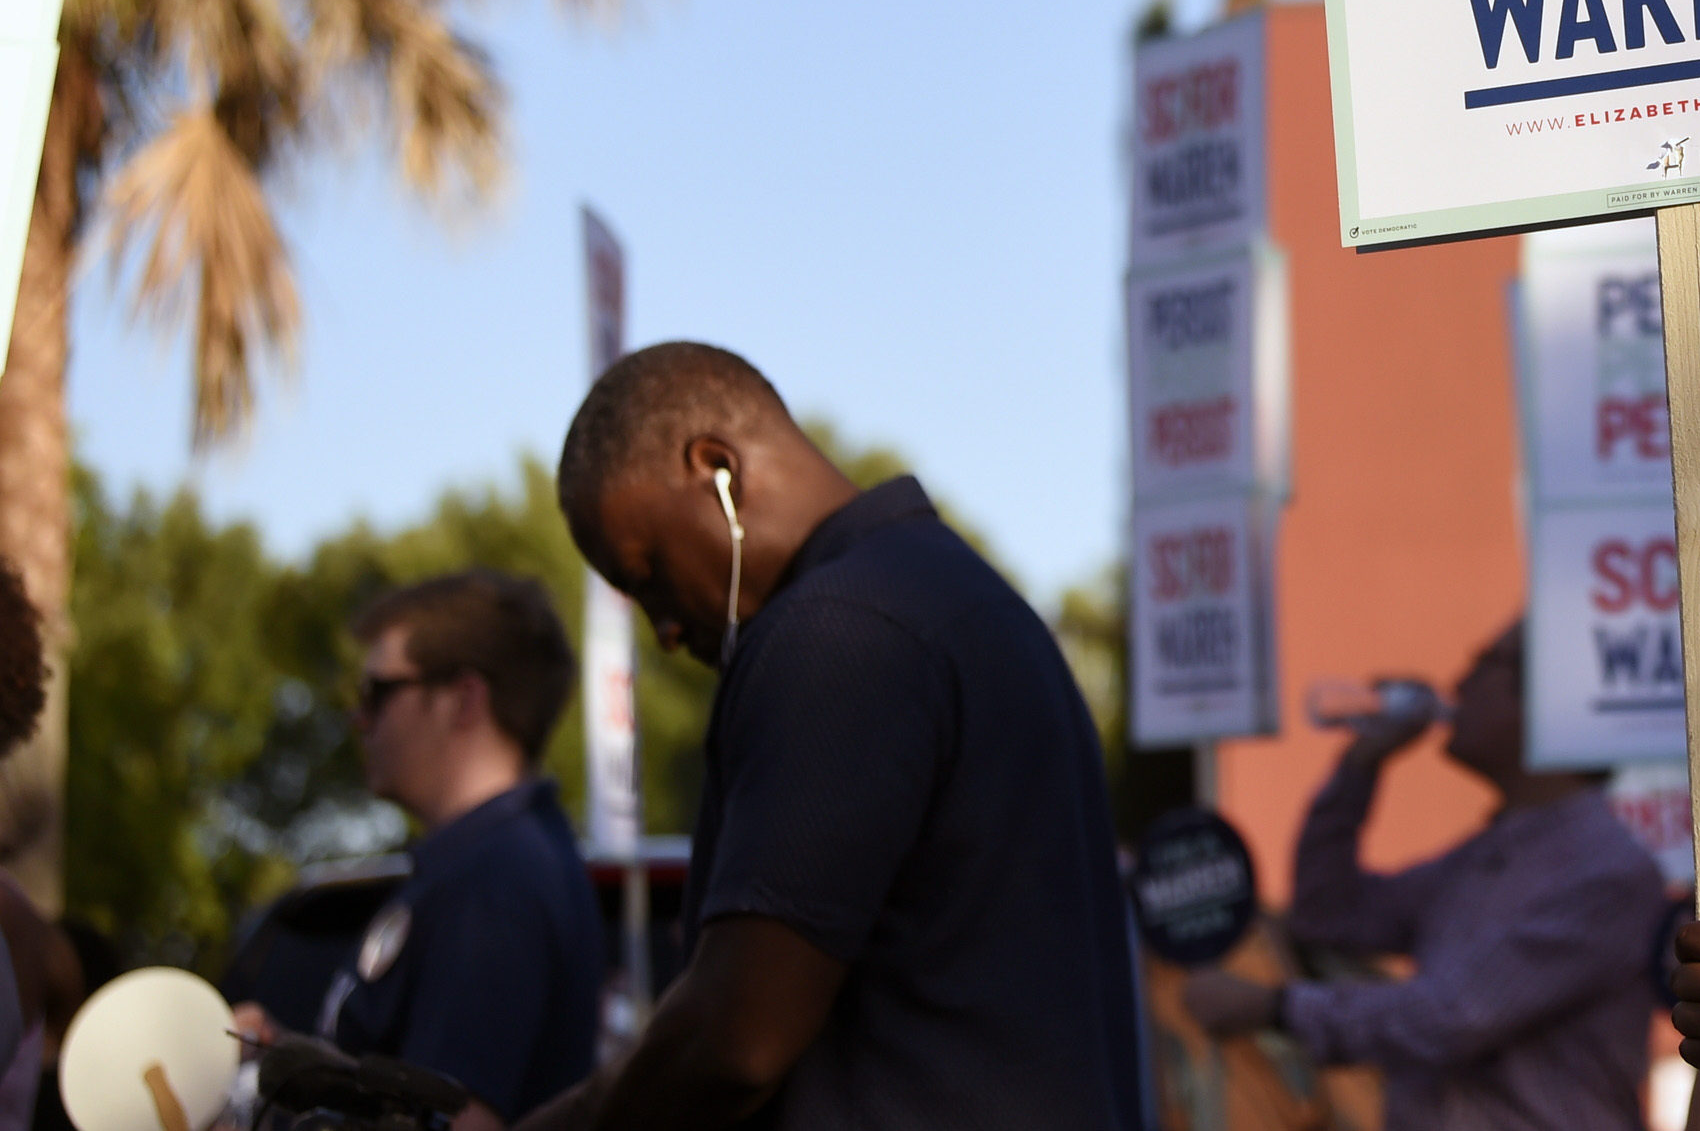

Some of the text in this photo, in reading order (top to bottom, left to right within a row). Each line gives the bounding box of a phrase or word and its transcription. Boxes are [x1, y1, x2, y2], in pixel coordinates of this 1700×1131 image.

[1611, 195, 1629, 203] PAID
[1632, 193, 1647, 201] FOR
[1663, 186, 1698, 196] WARREN
[1378, 223, 1417, 233] DEMOCRATIC
[1591, 535, 1679, 613] SC
